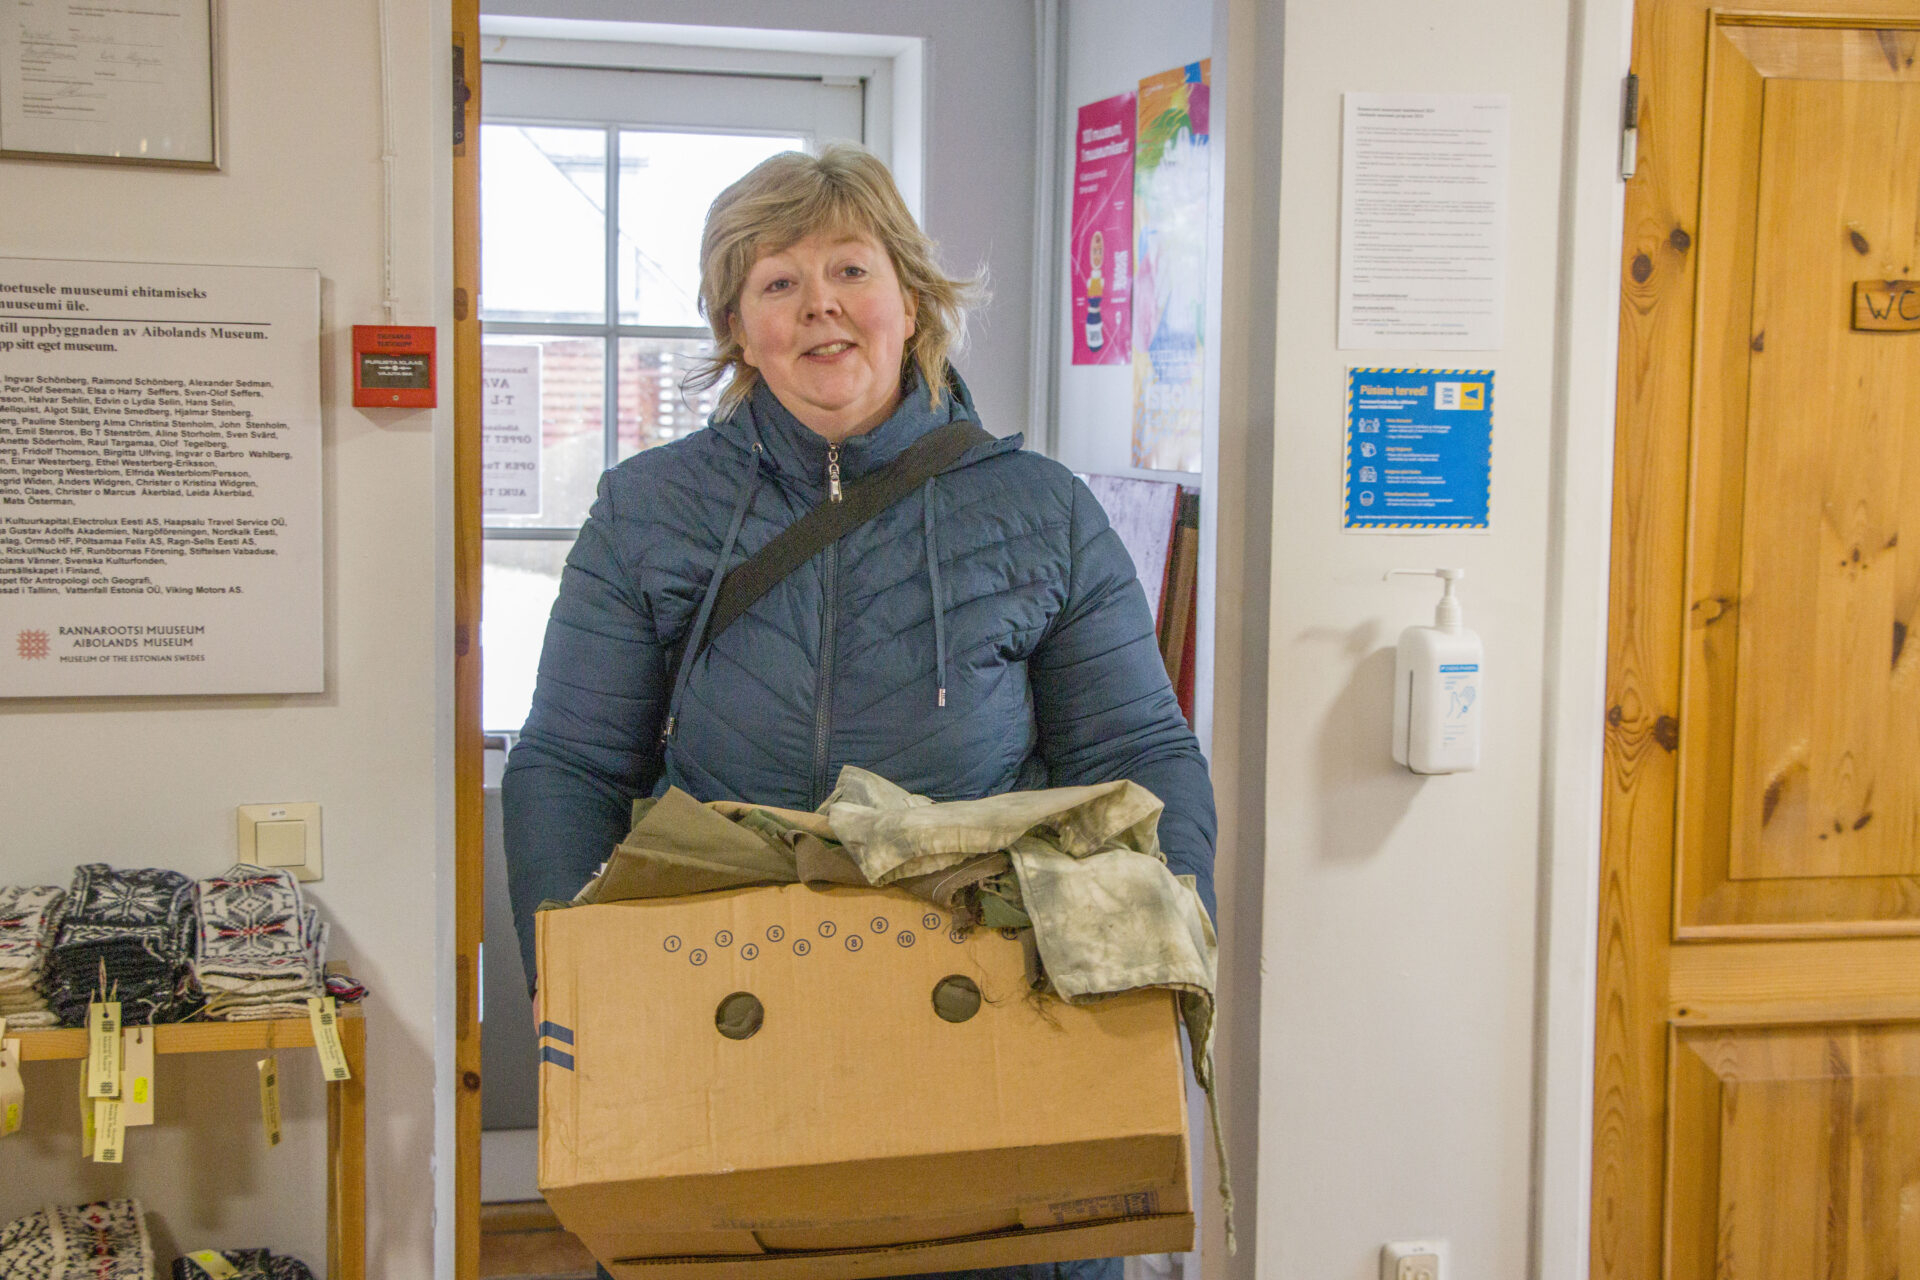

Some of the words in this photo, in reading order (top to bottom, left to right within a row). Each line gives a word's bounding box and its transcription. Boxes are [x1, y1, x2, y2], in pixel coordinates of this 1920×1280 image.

[60, 284, 128, 296] muuseumi
[132, 286, 206, 298] ehitamiseks
[66, 300, 88, 310] üle.
[1865, 290, 1920, 320] WC
[0, 322, 17, 333] till
[22, 323, 118, 338] uppbyggnaden
[123, 328, 135, 336] av
[143, 326, 206, 337] Aibolands
[210, 328, 268, 339] Museum.
[16, 339, 34, 349] sitt
[37, 339, 60, 352] eget
[64, 342, 117, 351] museum.
[59, 625, 143, 635] RANNAROOTSI
[146, 625, 204, 634] MUUSEUM
[74, 638, 138, 647] AIBOLANDS
[143, 637, 193, 647] MUUSEUM
[59, 654, 97, 662] MUSEUM
[99, 654, 109, 662] OF
[113, 654, 127, 662] THE
[174, 653, 204, 661] SWEDES
